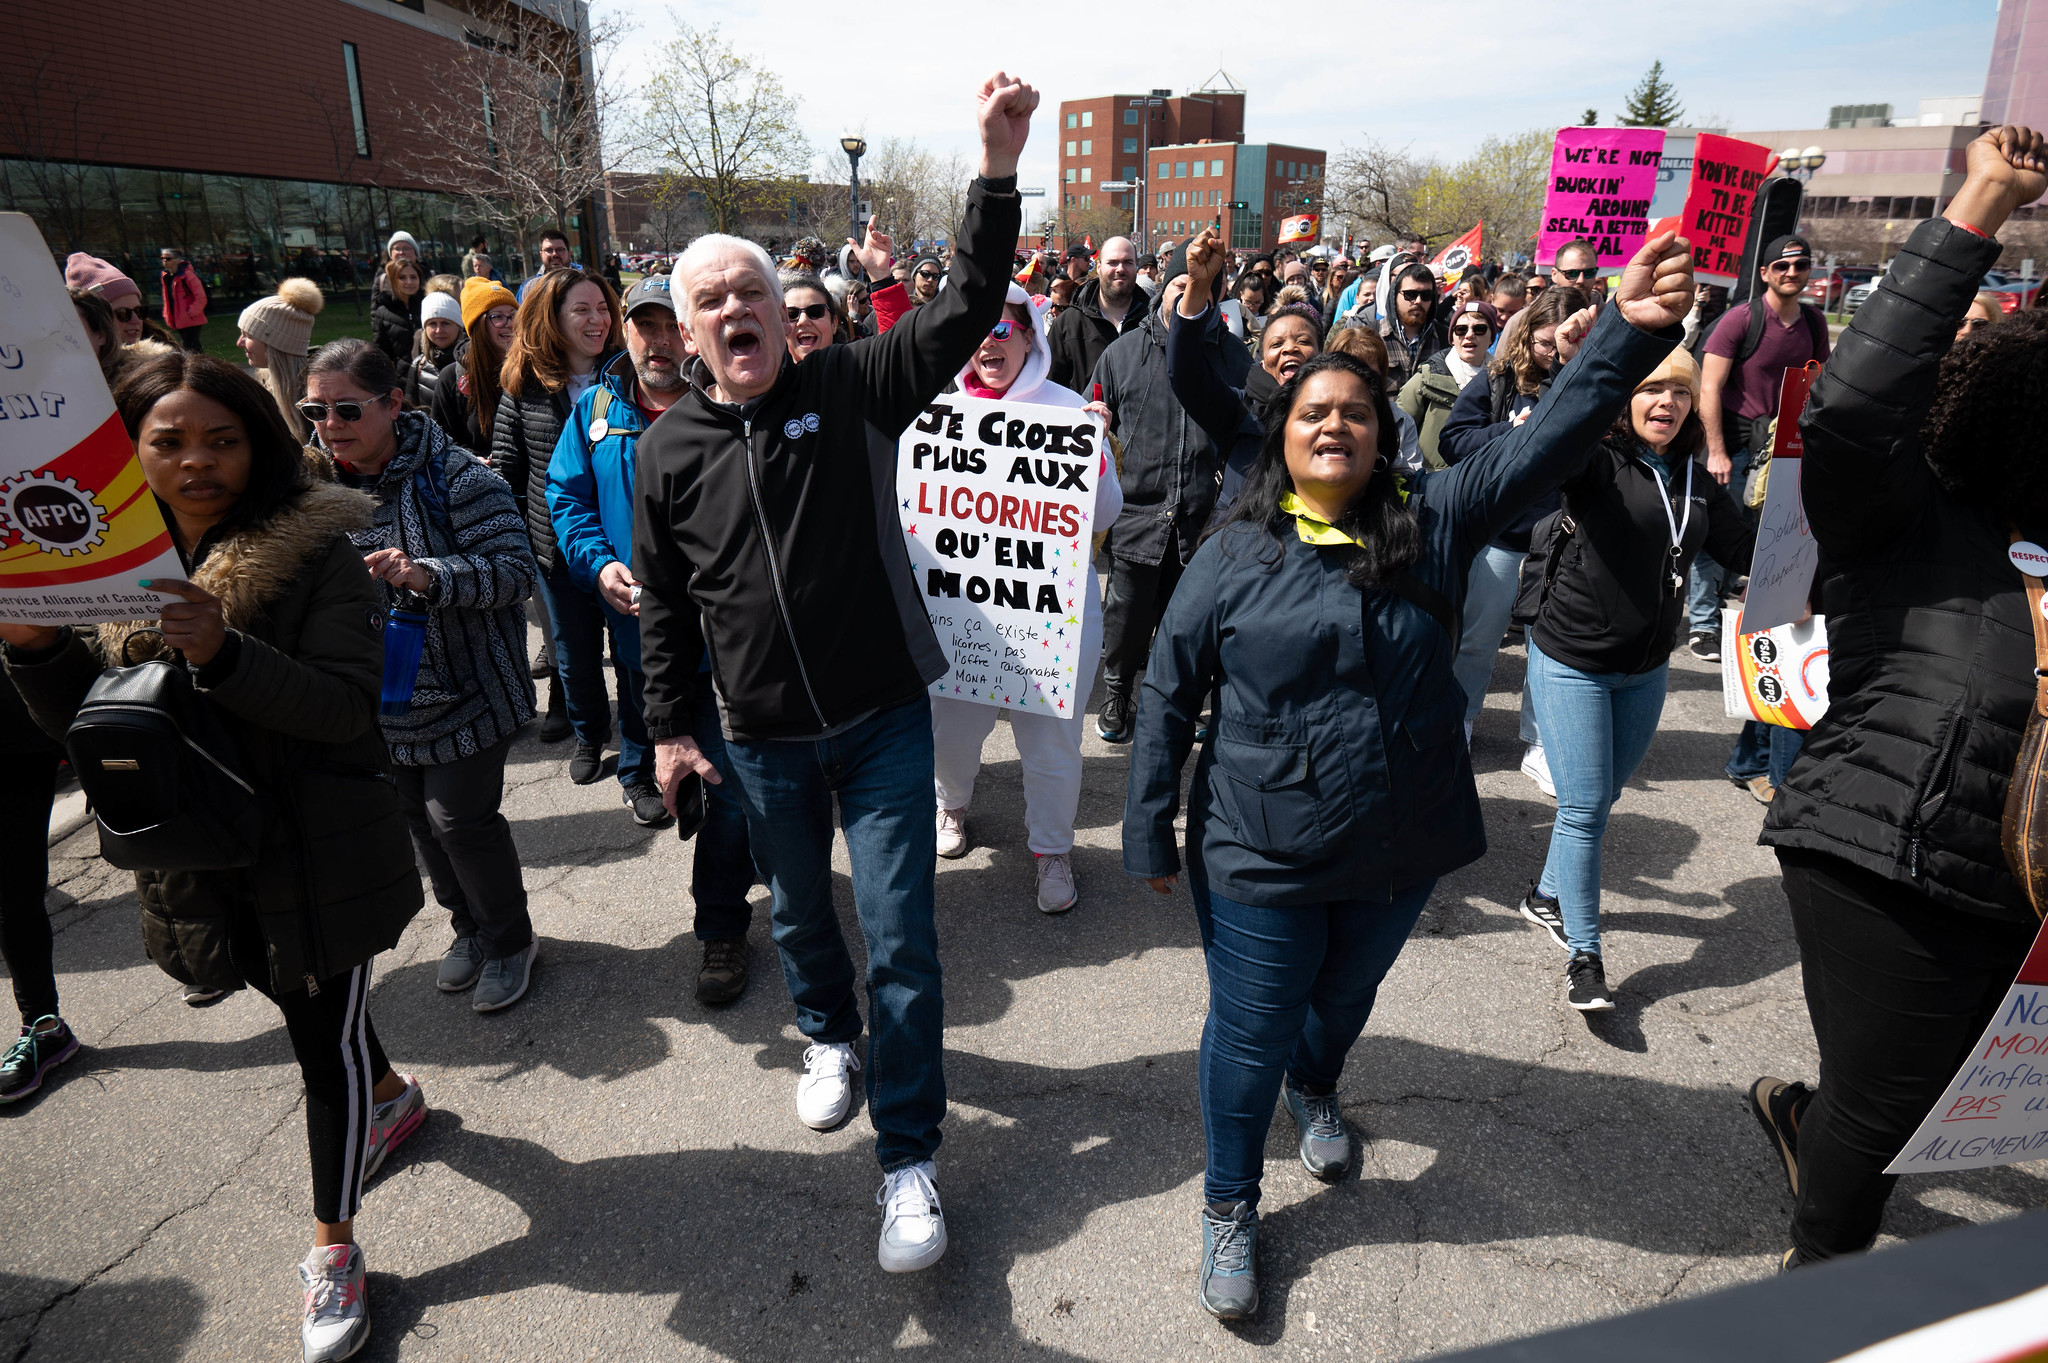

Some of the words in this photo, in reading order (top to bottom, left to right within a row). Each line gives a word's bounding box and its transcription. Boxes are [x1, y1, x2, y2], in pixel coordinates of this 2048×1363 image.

[1565, 146, 1620, 164] WE'RE
[1629, 150, 1662, 167] NOT
[1660, 159, 1693, 169] INEAU
[1555, 176, 1625, 195] DUCKIN'
[1698, 159, 1739, 187] YOU'VE
[1585, 198, 1650, 218] AROUND
[1712, 188, 1729, 211] TO
[1731, 193, 1747, 216] BE
[1546, 218, 1589, 233] SEAL
[1592, 219, 1604, 234] A
[1607, 220, 1648, 235] BETTER
[1695, 209, 1744, 238] KITTEN
[1575, 235, 1624, 256] EAL
[1709, 235, 1726, 249] ME
[1694, 247, 1712, 269] BE
[915, 403, 964, 441] JE
[978, 411, 1097, 458] CROIS
[913, 442, 987, 474] PLUS
[1006, 456, 1089, 492] AUX
[22, 502, 87, 528] AFPC
[918, 482, 1080, 538] LICORNES
[935, 527, 1045, 570] QU'EN
[0, 595, 40, 605] ervice
[43, 595, 94, 605] Alliance
[98, 593, 108, 604] of
[112, 592, 161, 604] Canada
[927, 568, 1063, 615] MONA
[7, 608, 21, 618] la
[20, 608, 74, 619] Fonction
[74, 606, 127, 619] publique
[129, 606, 144, 615] du
[145, 605, 163, 614] Ca
[930, 610, 953, 626] oins
[964, 618, 982, 639] ça
[995, 623, 1038, 641] existe
[1758, 638, 1771, 664] PSAC
[954, 650, 989, 667] l'offre
[1000, 661, 1060, 679] raisonnable
[955, 669, 987, 684] MONA
[1763, 677, 1776, 702] AFPC
[1960, 1063, 2048, 1090] l'infla
[1946, 1095, 2007, 1118] PAS
[2024, 1097, 2048, 1112] u
